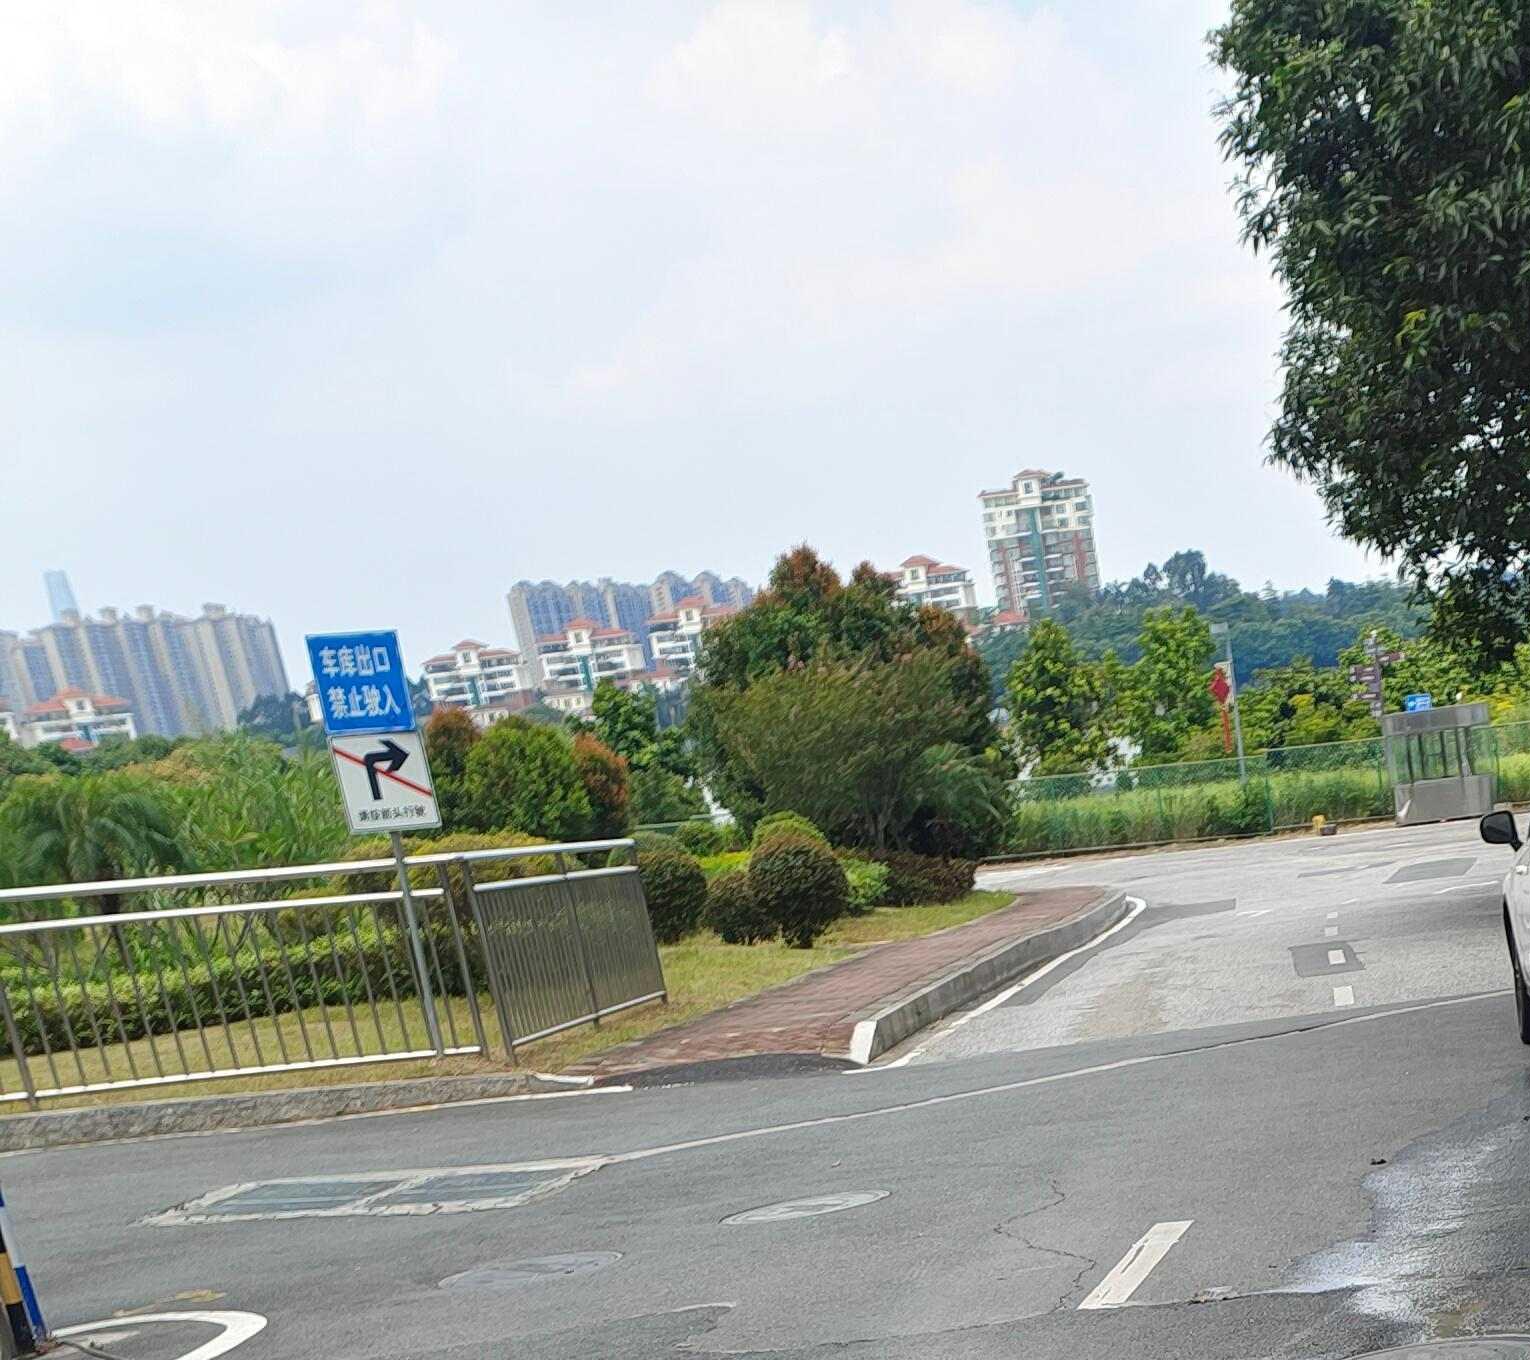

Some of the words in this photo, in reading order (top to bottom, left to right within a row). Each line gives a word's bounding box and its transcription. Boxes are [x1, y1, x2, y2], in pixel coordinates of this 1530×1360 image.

[319, 644, 391, 678] 车库出口
[327, 684, 401, 719] 禁止驶入
